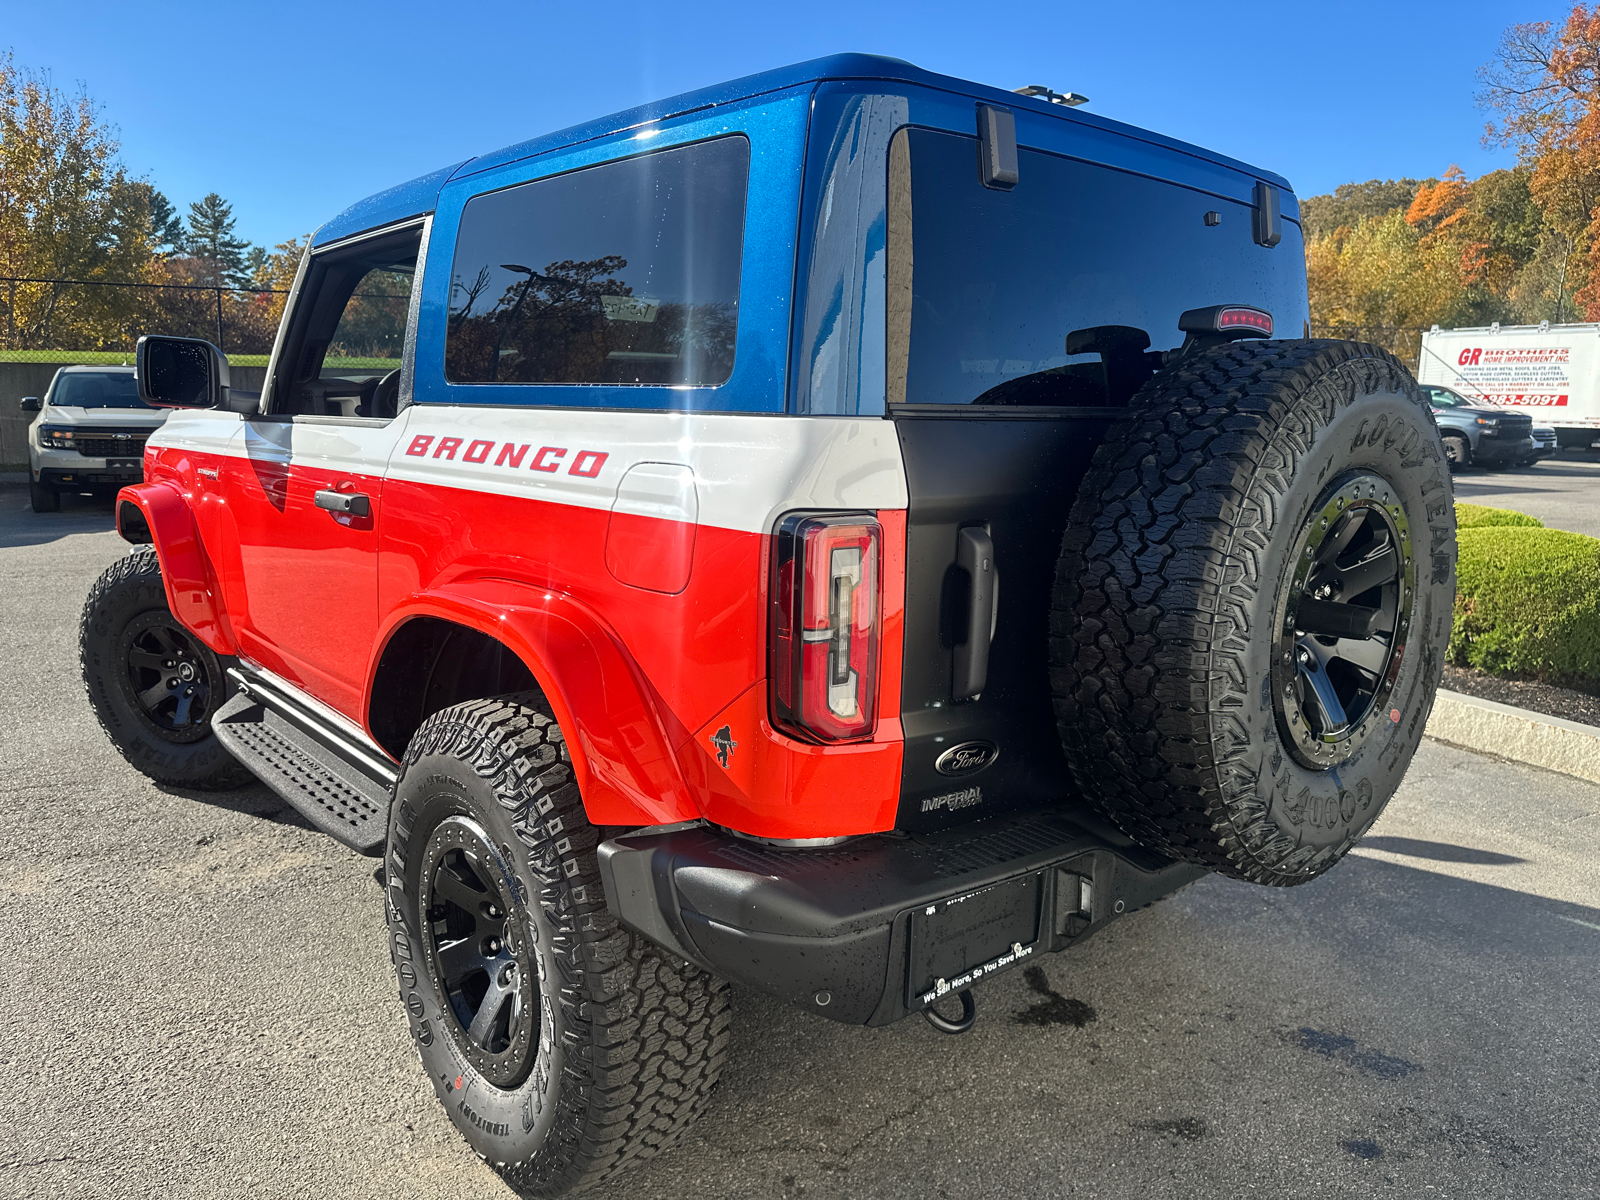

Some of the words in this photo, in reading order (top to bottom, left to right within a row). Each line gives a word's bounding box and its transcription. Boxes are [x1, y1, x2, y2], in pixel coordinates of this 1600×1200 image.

[1458, 348, 1482, 366] GR
[1504, 355, 1554, 363] IMPROVEMENT
[405, 434, 609, 479] BRONCO
[952, 748, 986, 770] Ford
[920, 786, 982, 812] IMPERIAL
[923, 993, 936, 1004] We
[936, 982, 951, 997] Sell
[952, 975, 972, 990] More,
[973, 968, 983, 979] So
[983, 962, 997, 974] You
[998, 953, 1014, 967] Save
[1015, 946, 1033, 960] More
[439, 1072, 454, 1095] RT
[457, 1099, 510, 1137] TERRITORY
